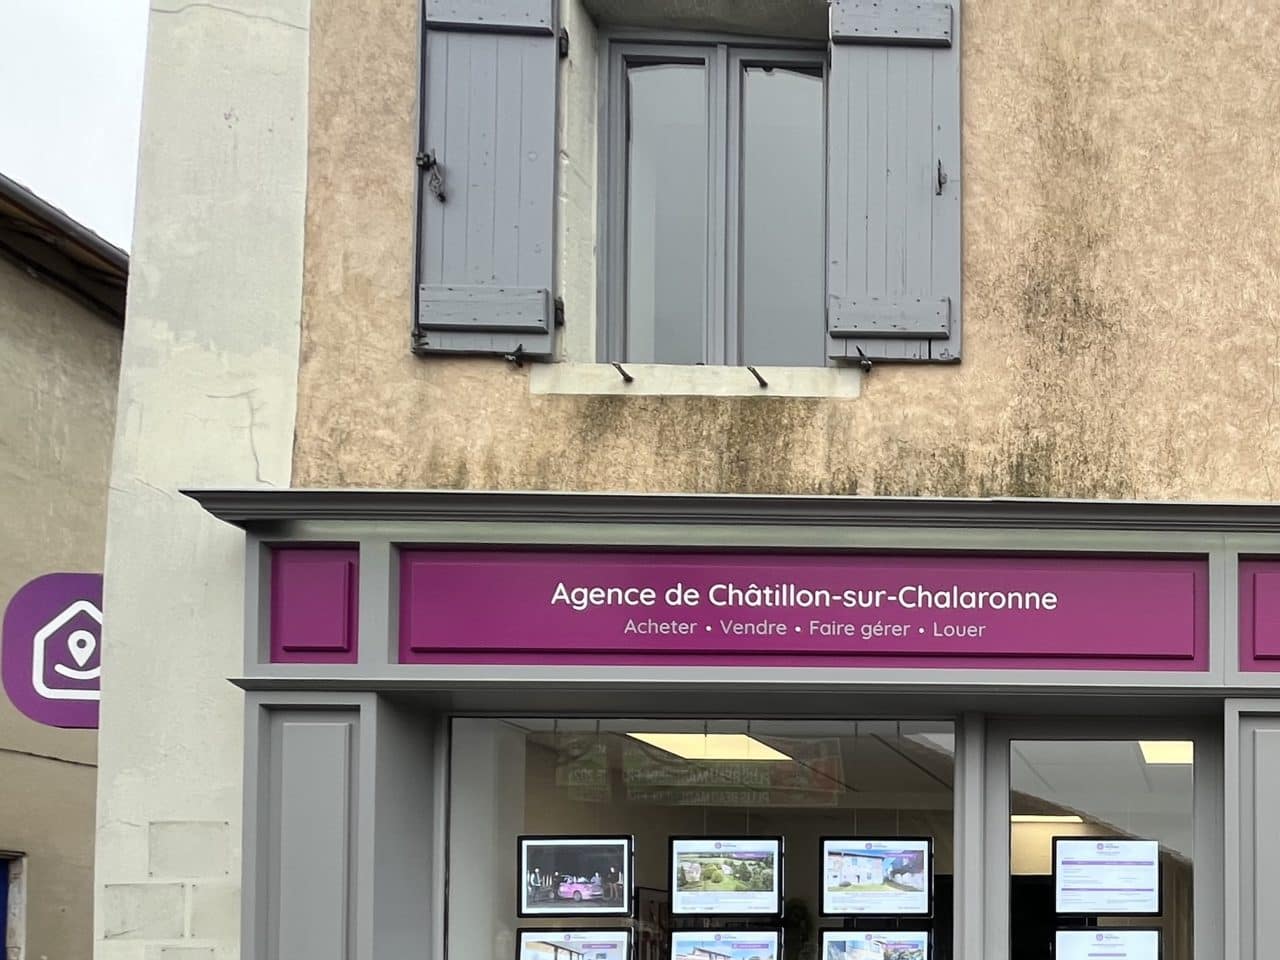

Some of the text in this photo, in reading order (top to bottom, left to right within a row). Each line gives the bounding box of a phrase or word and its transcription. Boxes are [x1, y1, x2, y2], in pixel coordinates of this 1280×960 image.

[551, 582, 1057, 610] Agence de Châtillon-sur-Chalaronne
[624, 619, 986, 640] Acheter Vendre Faire gérer Louer
